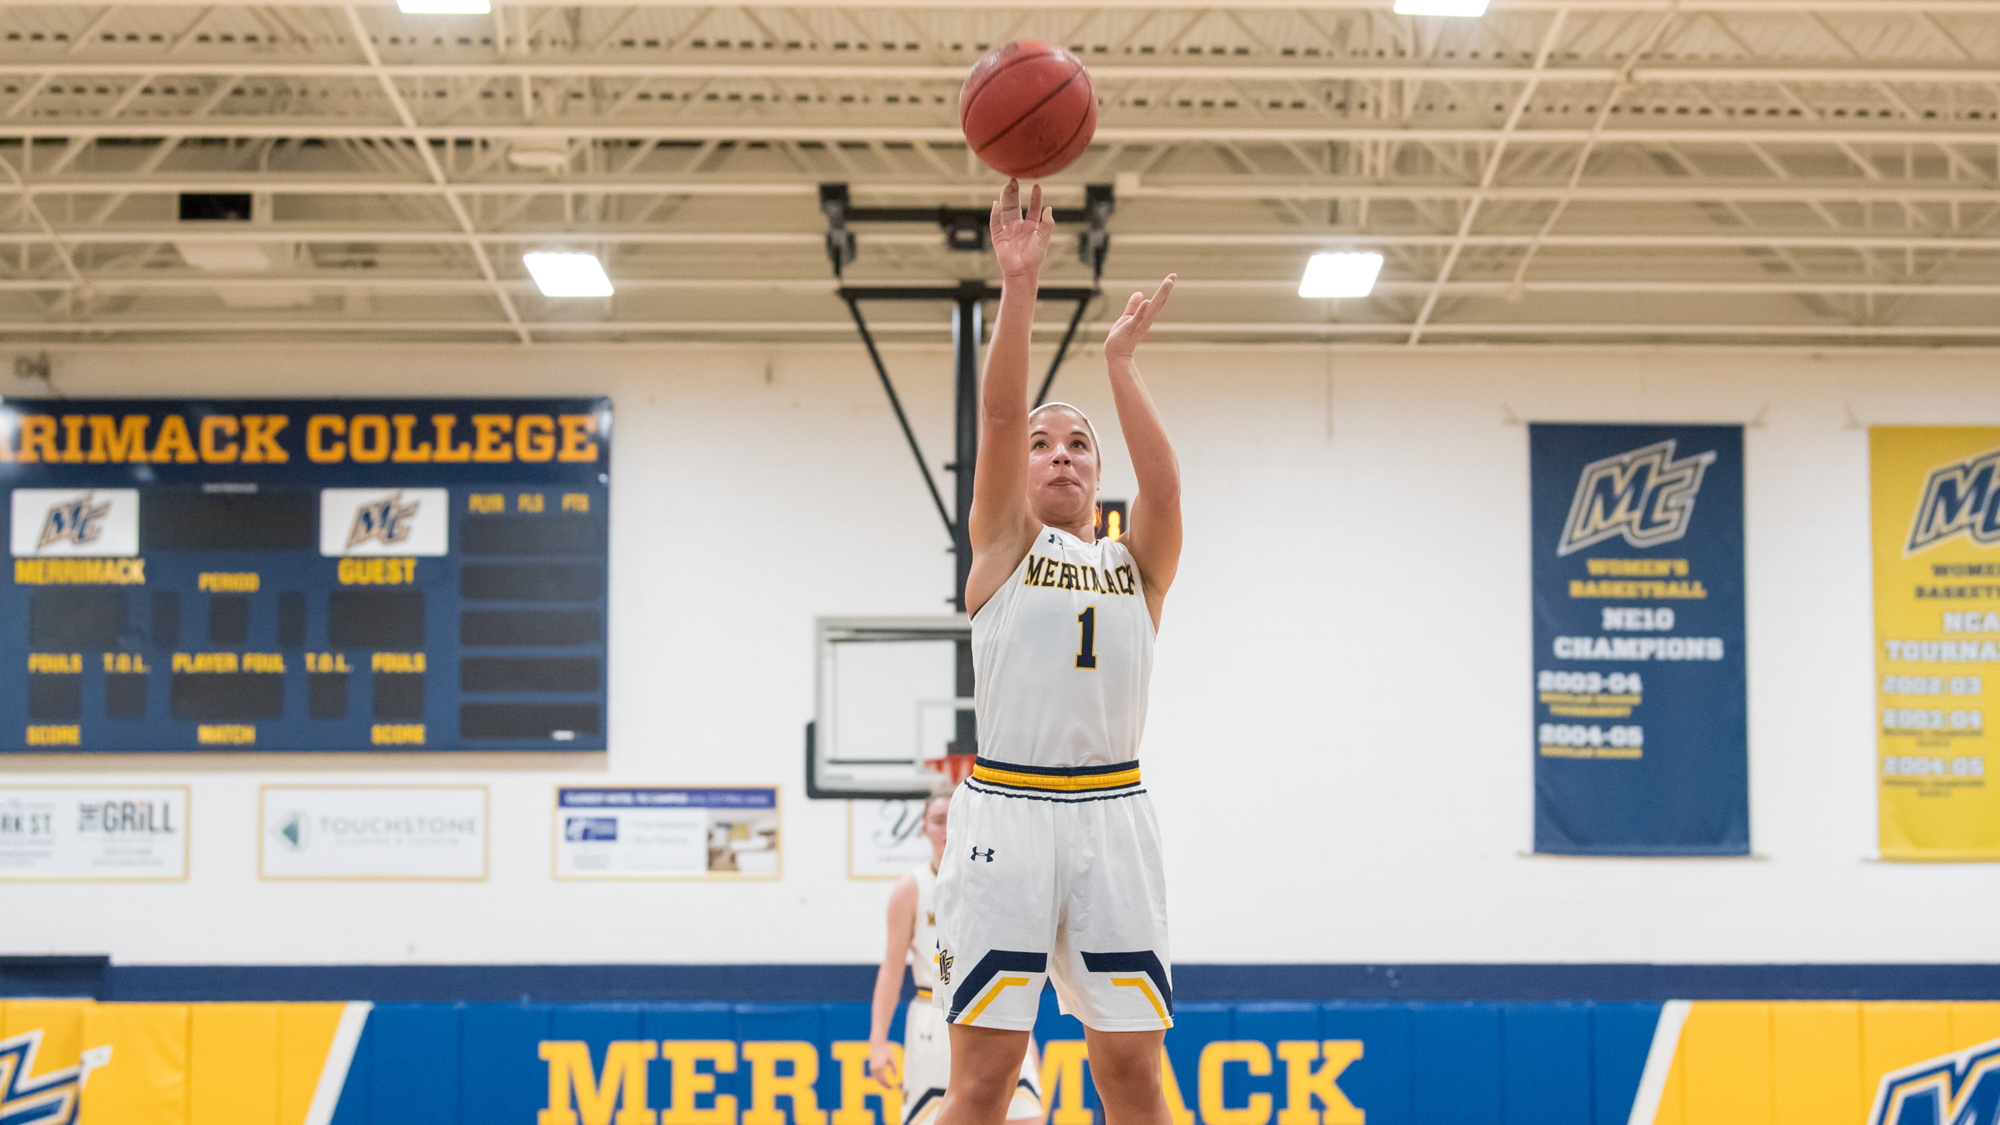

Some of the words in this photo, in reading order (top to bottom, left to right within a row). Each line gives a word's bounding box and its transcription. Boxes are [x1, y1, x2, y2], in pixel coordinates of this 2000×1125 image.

[306, 414, 599, 463] COLLEGE
[517, 493, 545, 513] FLS
[561, 493, 590, 513] PTS
[14, 558, 146, 585] MERRIMACK
[338, 558, 416, 585] GUEST
[1587, 559, 1689, 577] WOMEN'S
[1931, 563, 2000, 577] WOME
[198, 572, 260, 592] PERIOD
[1569, 581, 1708, 599] BASKETBALL
[1602, 607, 1675, 631] NE10
[1075, 605, 1097, 670] 1
[1553, 636, 1725, 660] CHAMPIONS
[1884, 639, 2000, 662] TOURNA
[28, 653, 83, 674] FOULS
[172, 653, 239, 674] PLAYER
[243, 653, 286, 674] FOUL
[371, 653, 426, 674] FOULS
[1538, 670, 1643, 693] 2003-04
[26, 725, 82, 746] SCORE
[198, 725, 257, 744] MATCH
[371, 724, 426, 745] SCORE
[1539, 723, 1644, 747] 2004-05
[320, 815, 477, 835] TOUCHSTONE
